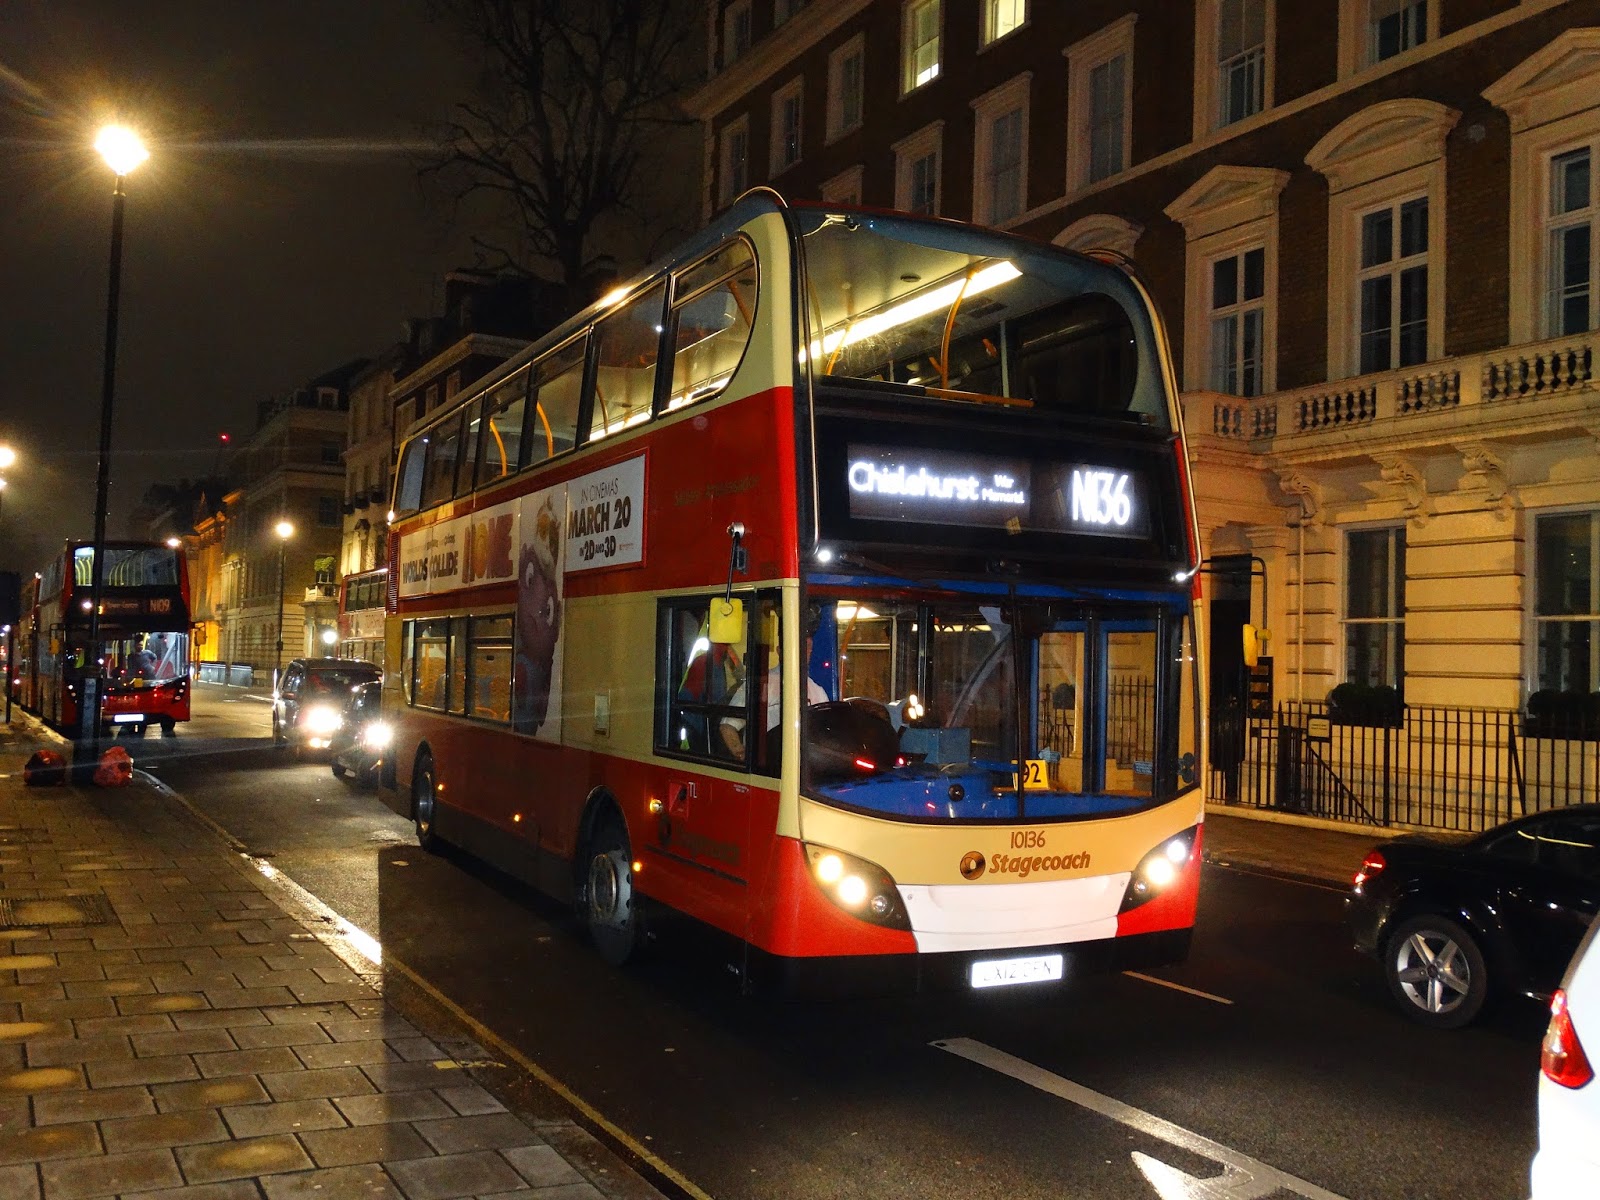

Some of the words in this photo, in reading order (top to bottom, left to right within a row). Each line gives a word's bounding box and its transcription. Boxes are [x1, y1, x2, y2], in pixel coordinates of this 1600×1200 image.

[589, 477, 619, 502] CINEMAS
[849, 461, 979, 501] Chislehurst
[1071, 469, 1132, 526] N136
[568, 501, 611, 539] MARCH
[613, 495, 632, 530] 20
[462, 513, 514, 584] HOME
[584, 539, 595, 561] 2D
[604, 535, 617, 558] 3D
[402, 557, 429, 585] WORLDS
[429, 550, 459, 580] COLLIDE
[1010, 830, 1046, 849] 10136
[989, 850, 1092, 878] Stagecoach
